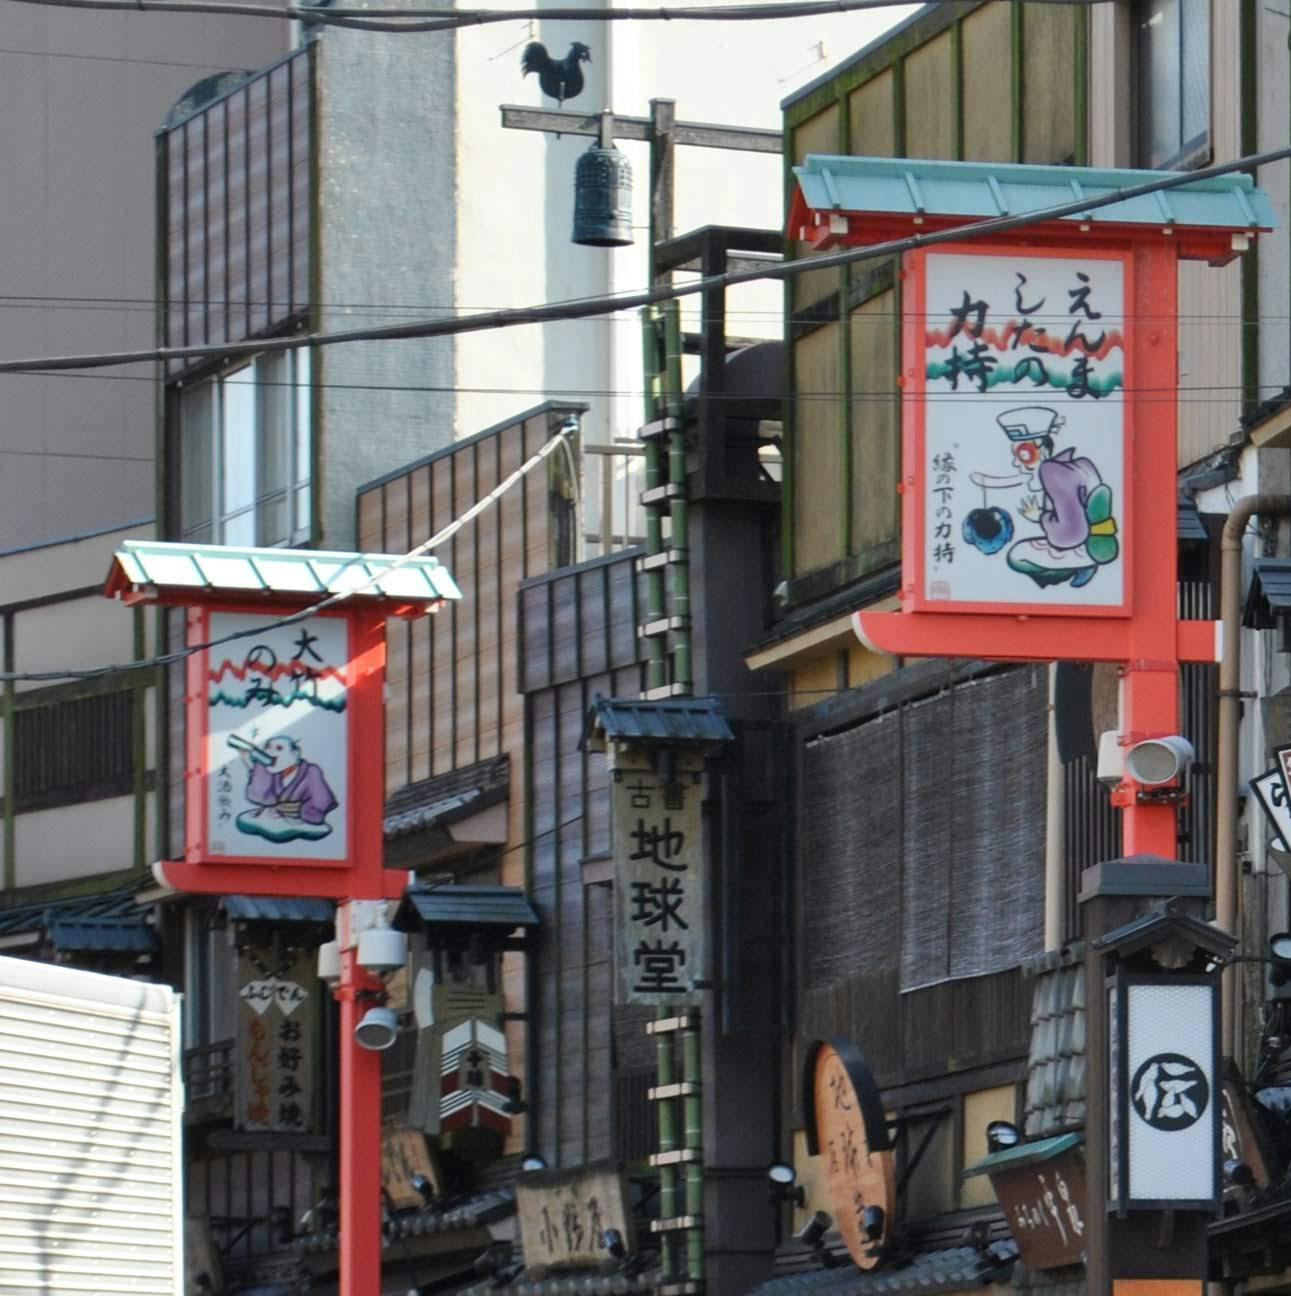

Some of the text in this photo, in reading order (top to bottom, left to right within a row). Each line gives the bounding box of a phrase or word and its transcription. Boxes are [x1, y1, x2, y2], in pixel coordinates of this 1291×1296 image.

[945, 291, 997, 393] 力持
[1012, 272, 1050, 388] したの
[1063, 272, 1104, 399] えんま
[629, 817, 689, 994] 地球堂
[1134, 1059, 1198, 1120] 伝
